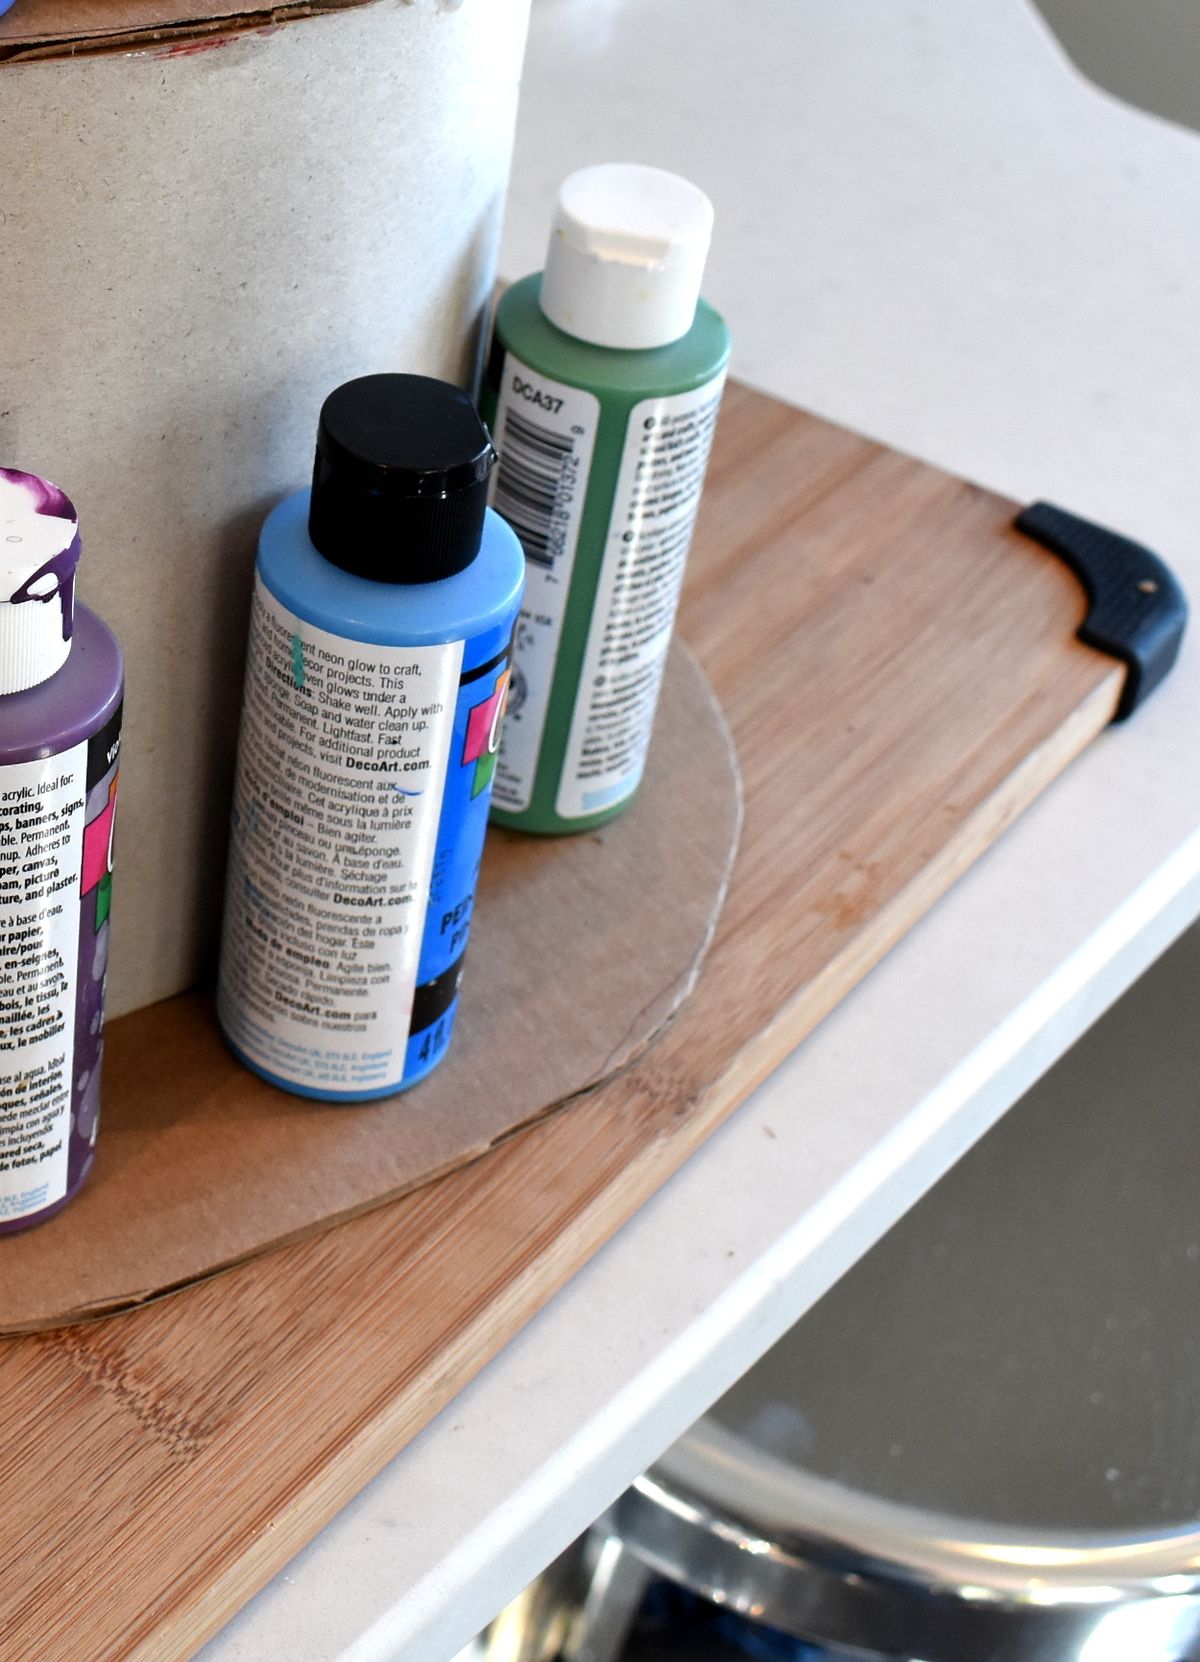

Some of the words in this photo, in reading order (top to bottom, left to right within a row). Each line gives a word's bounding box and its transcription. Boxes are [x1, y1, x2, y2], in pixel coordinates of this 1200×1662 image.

[512, 376, 564, 415] DCA37
[348, 658, 376, 673] glow
[380, 677, 404, 690] This
[318, 691, 351, 711] Shake
[384, 706, 421, 719] Apply
[363, 691, 396, 704] under
[321, 708, 342, 723] and
[345, 717, 375, 730] water
[378, 720, 408, 732] clean
[319, 736, 374, 758] additional
[377, 746, 420, 760] product
[16, 913, 37, 926] base
